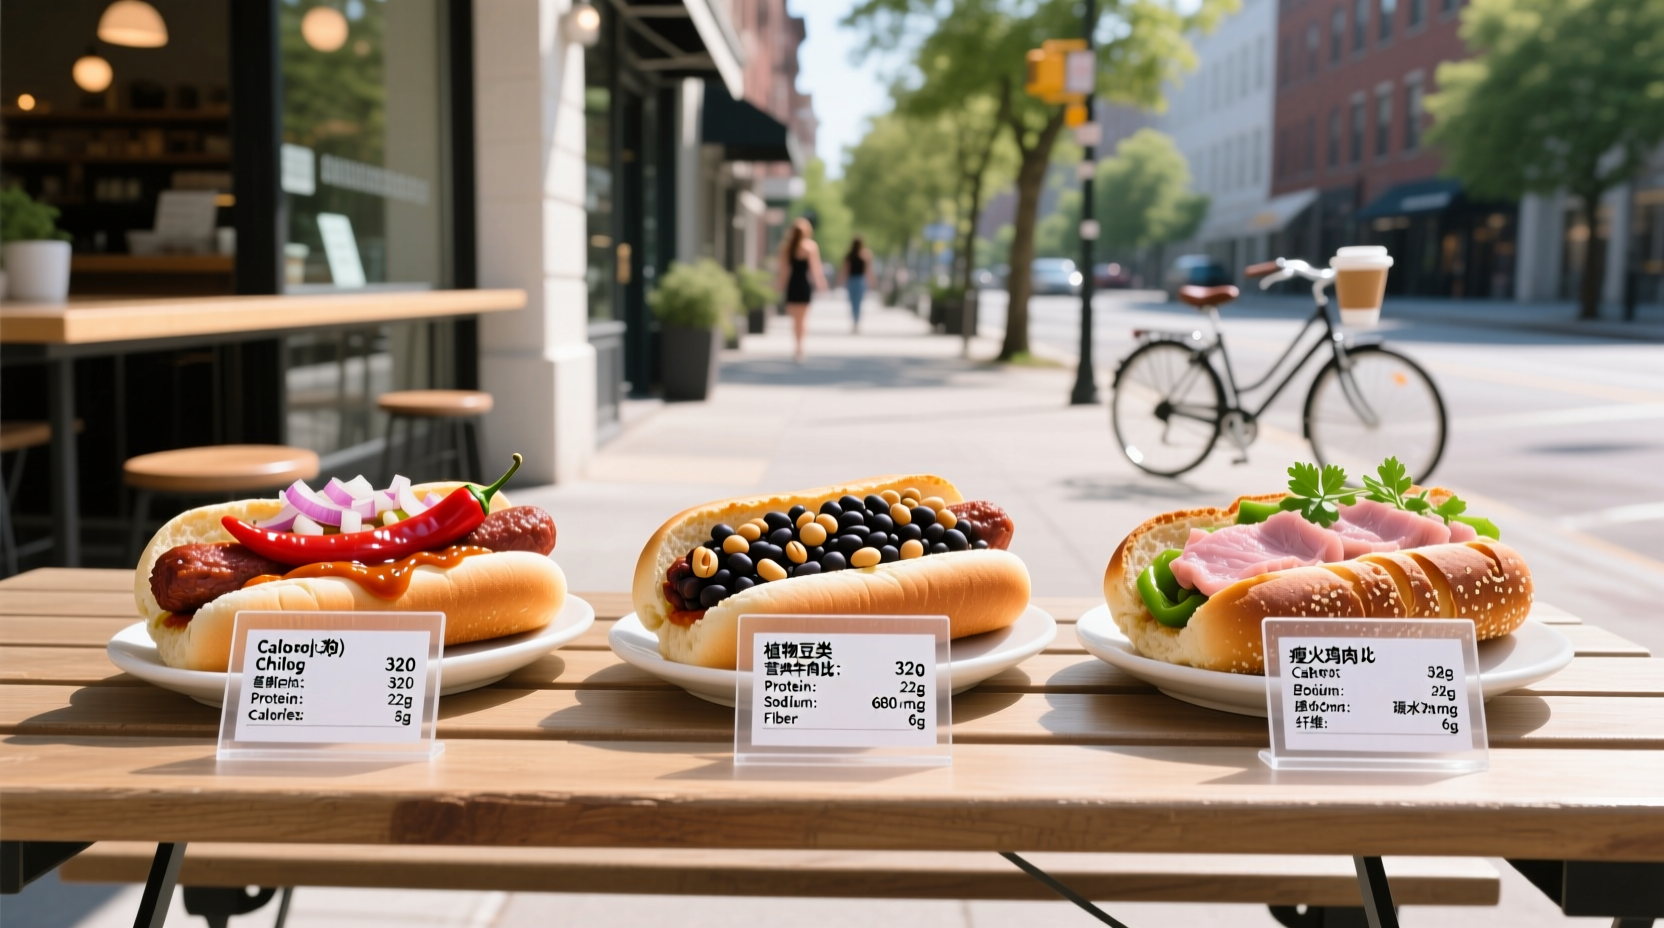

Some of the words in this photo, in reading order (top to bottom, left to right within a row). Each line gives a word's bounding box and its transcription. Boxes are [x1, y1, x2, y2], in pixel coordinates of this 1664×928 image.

[763, 641, 833, 660] 植物豆类
[385, 657, 416, 672] 320
[387, 677, 414, 689] 320
[764, 680, 817, 692] Protein:
[900, 681, 925, 698] 22g
[251, 692, 303, 705] Protein:
[387, 693, 413, 709] 22g
[908, 714, 925, 730] 6g
[1442, 718, 1459, 734] 6g
